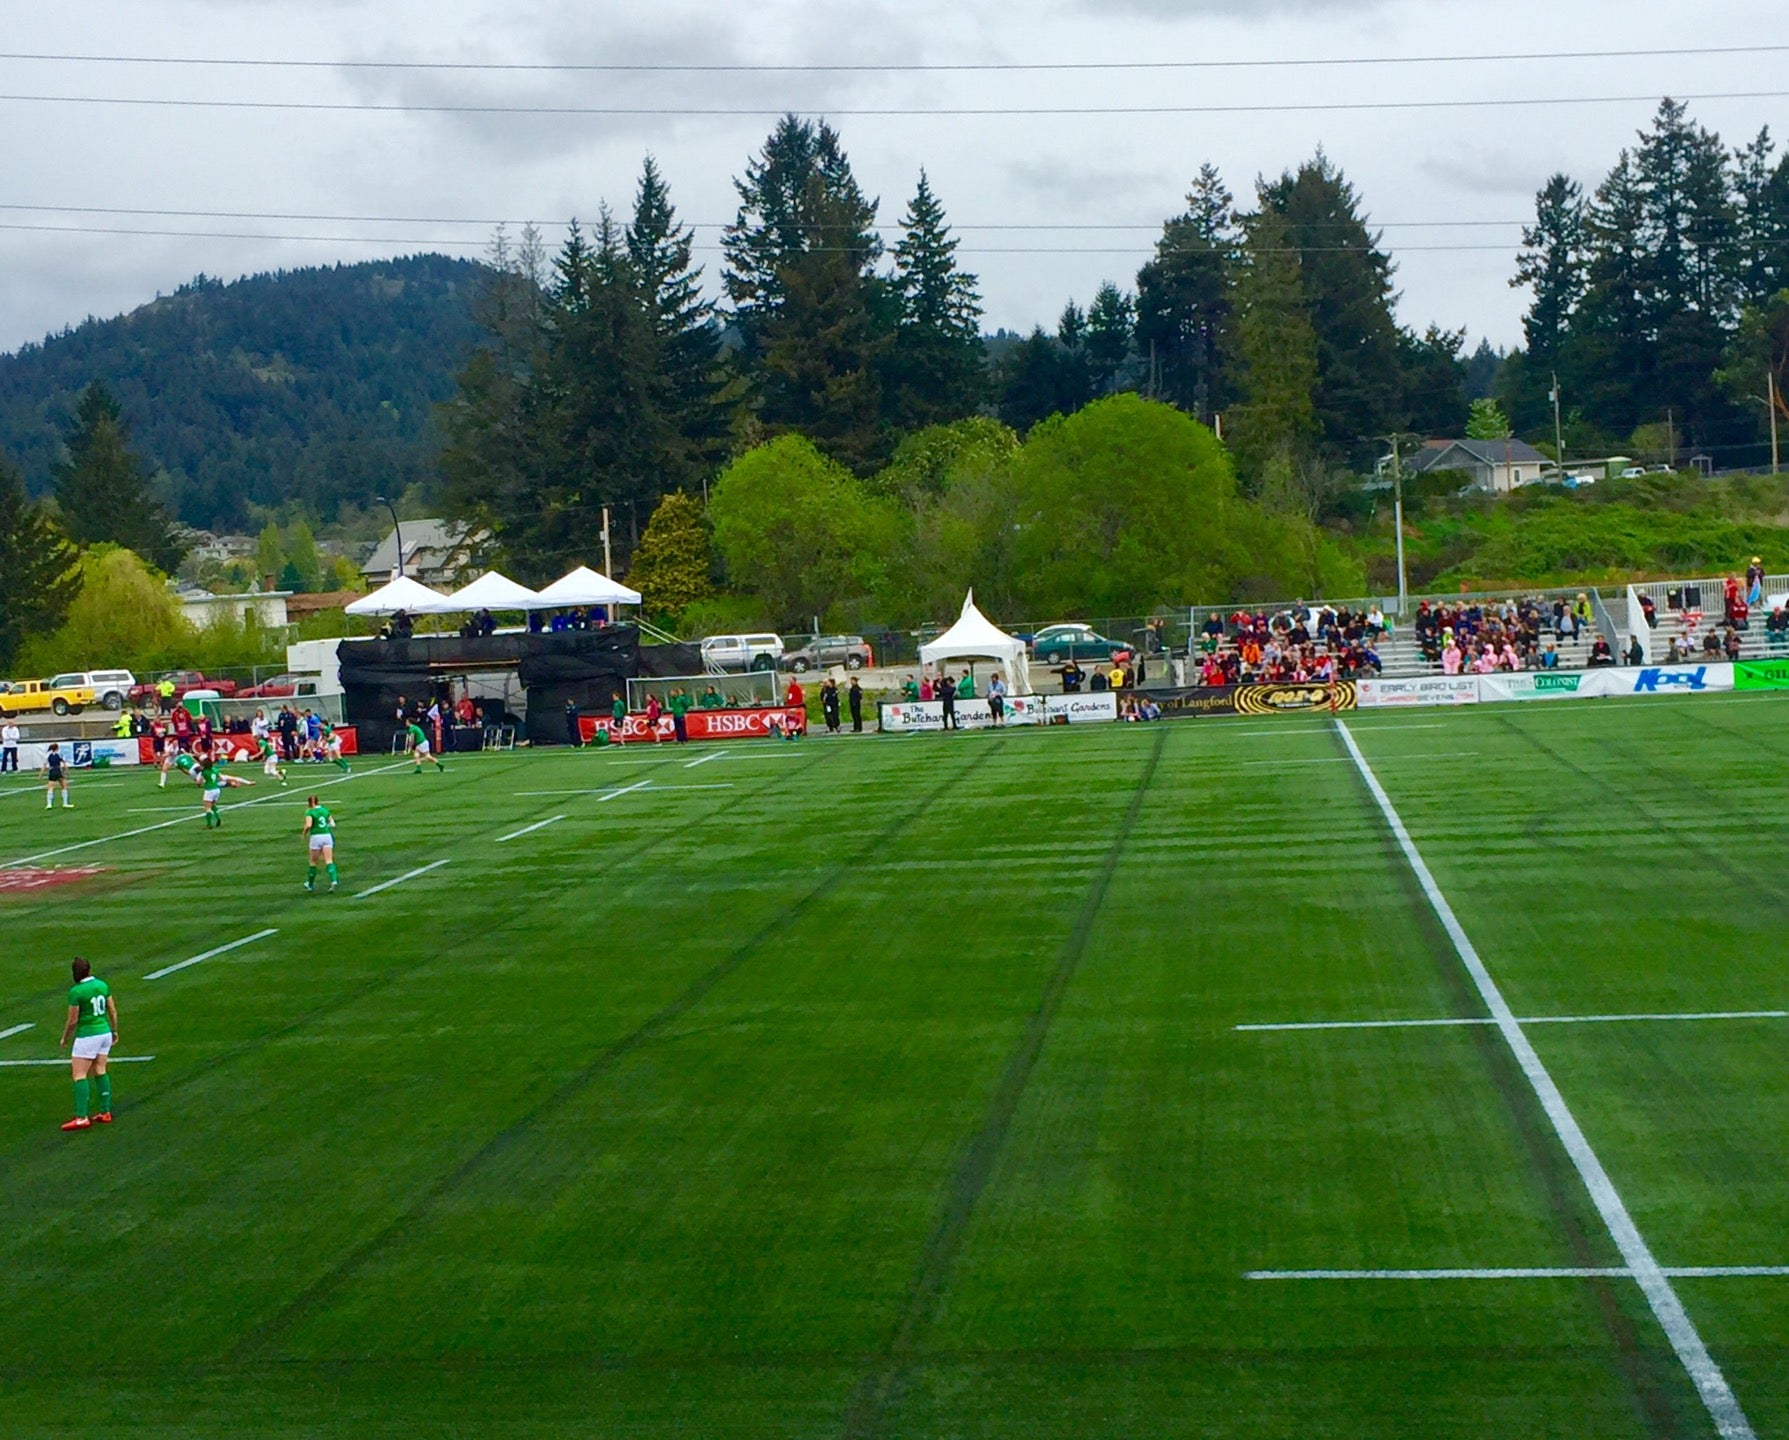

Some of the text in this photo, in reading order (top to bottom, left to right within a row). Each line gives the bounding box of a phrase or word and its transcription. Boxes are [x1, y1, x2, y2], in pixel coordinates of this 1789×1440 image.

[1380, 681, 1475, 693] EARLY BIRD LIST
[1071, 702, 1111, 713] Gardens
[1182, 694, 1233, 710] Langford
[910, 705, 924, 713] The
[706, 715, 760, 733] HSBC
[902, 712, 944, 724] Butchar
[318, 816, 327, 828] 3
[90, 995, 106, 1017] 10
